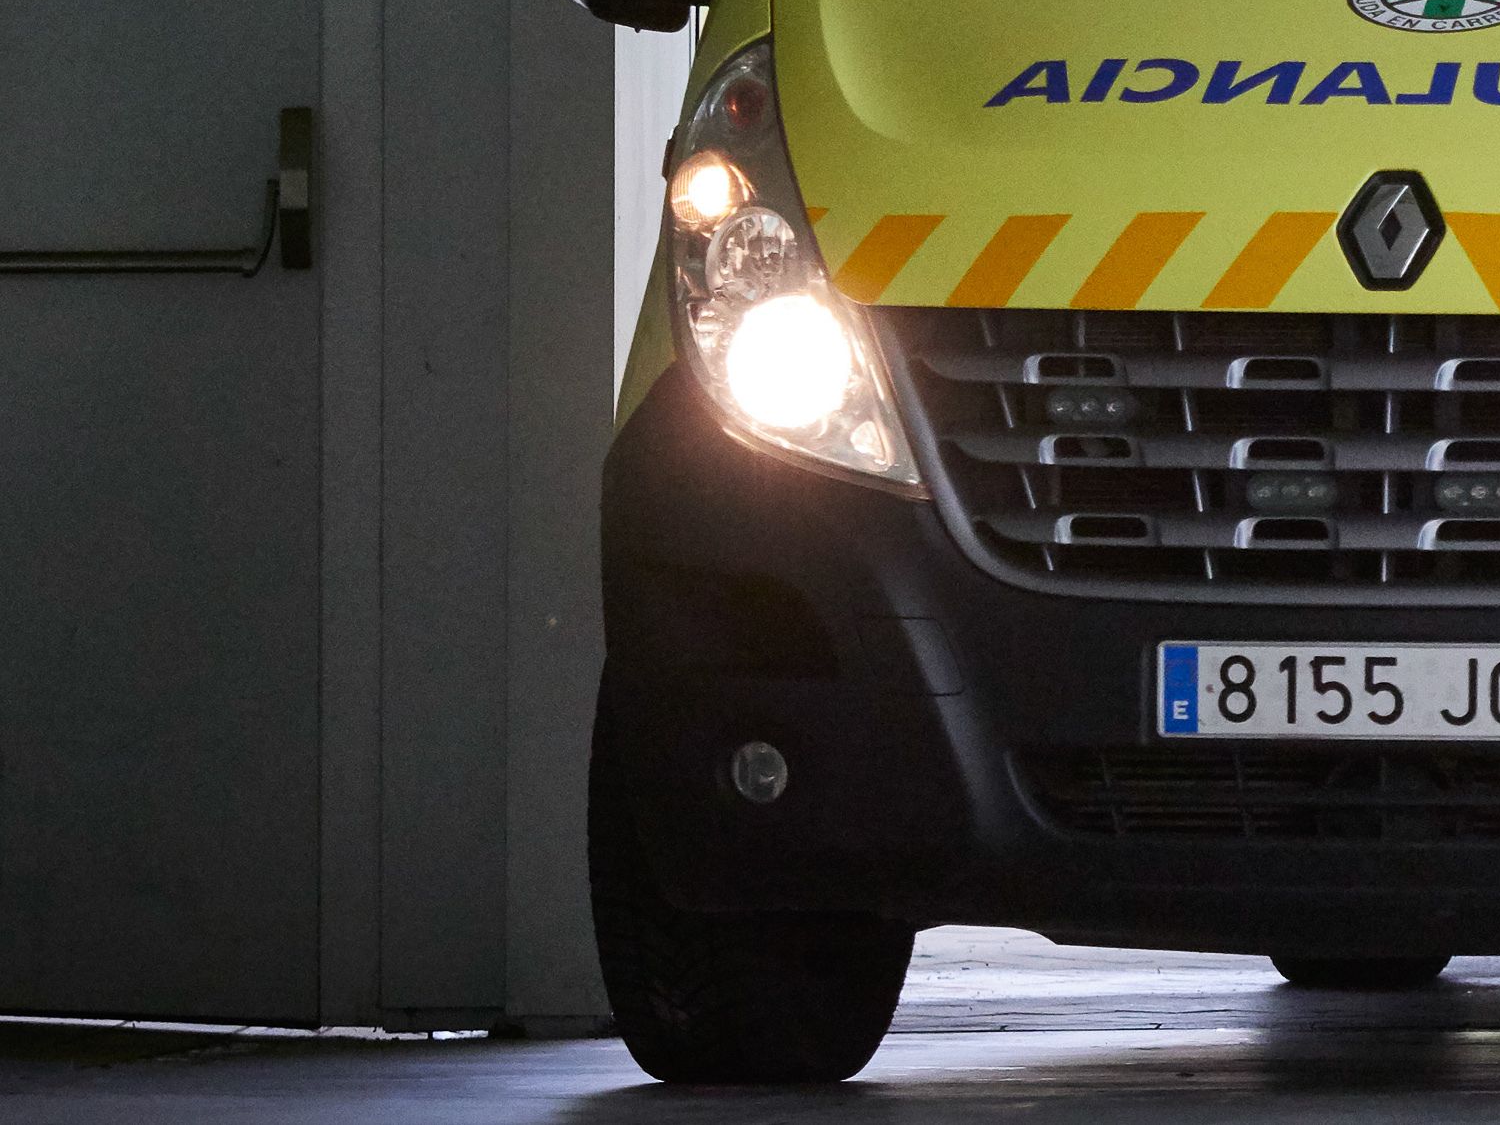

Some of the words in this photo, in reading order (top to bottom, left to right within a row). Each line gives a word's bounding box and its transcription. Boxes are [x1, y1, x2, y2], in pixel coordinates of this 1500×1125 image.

[1388, 15, 1419, 30] EN
[1173, 700, 1189, 720] E
[1217, 654, 1405, 725] 8155
